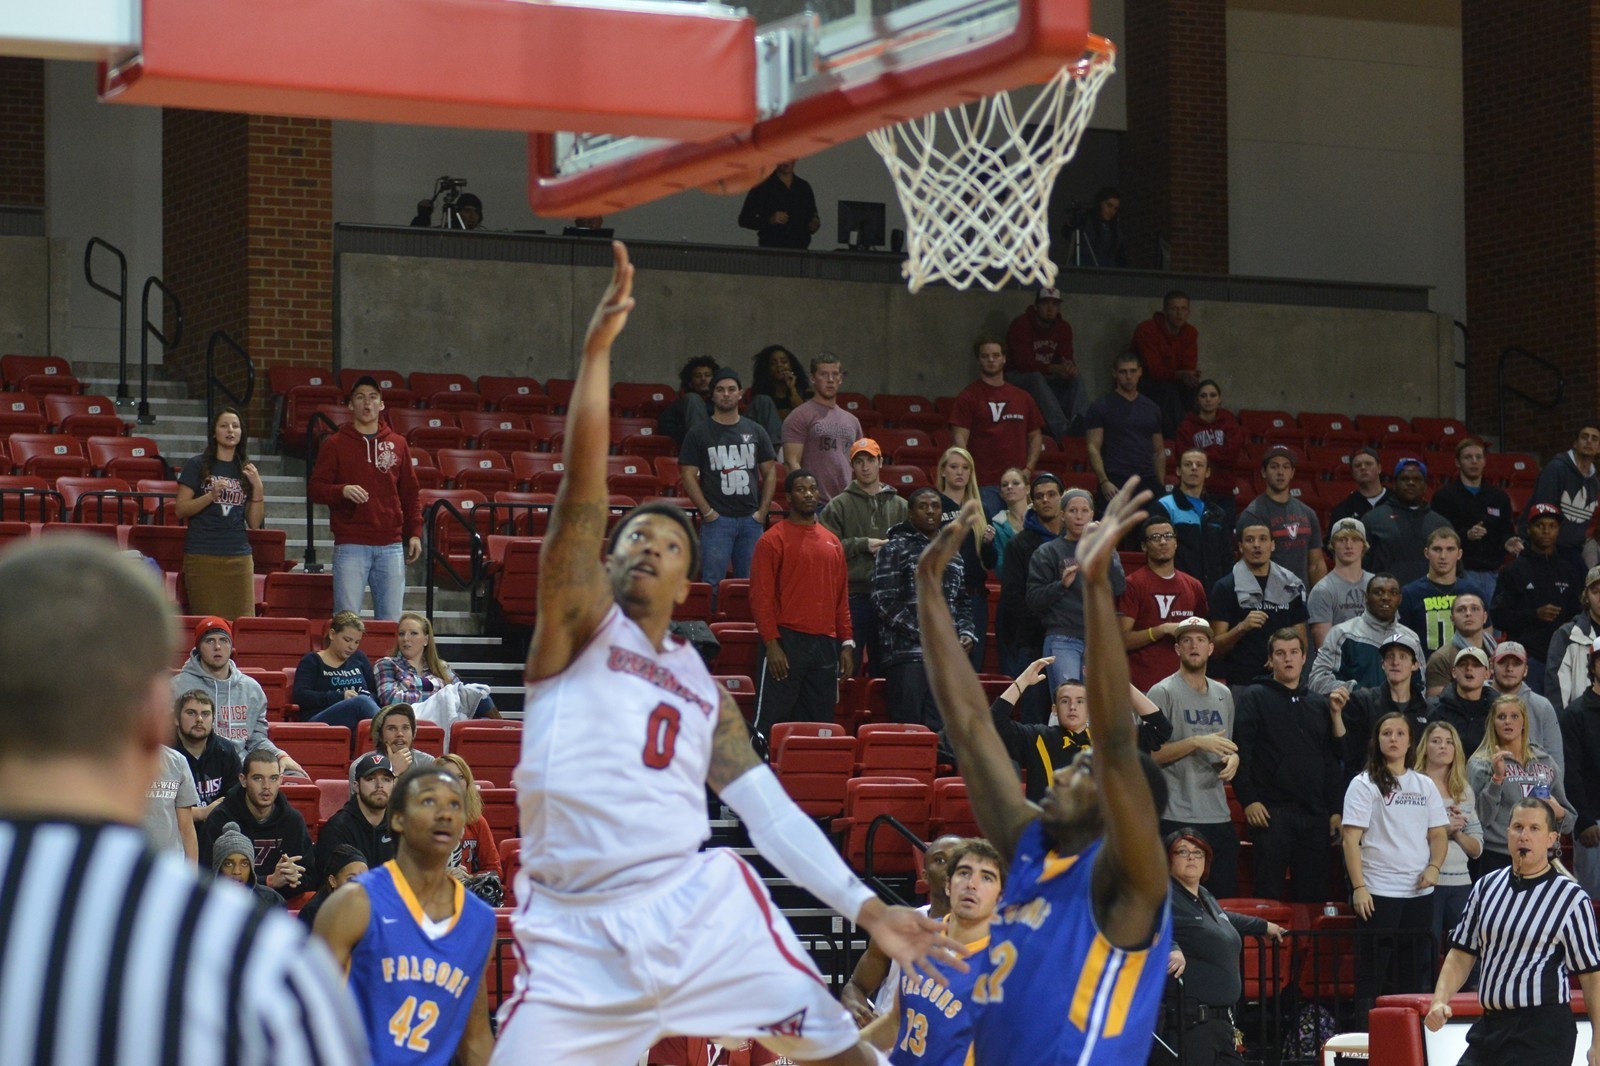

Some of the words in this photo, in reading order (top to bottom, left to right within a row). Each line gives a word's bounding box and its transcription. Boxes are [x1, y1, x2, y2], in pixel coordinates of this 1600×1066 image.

[988, 402, 1006, 422] V
[708, 443, 755, 471] MAN
[1154, 594, 1176, 619] V
[1183, 709, 1223, 726] USA
[642, 701, 681, 770] 0
[388, 995, 441, 1053] 42
[900, 1007, 929, 1058] 13
